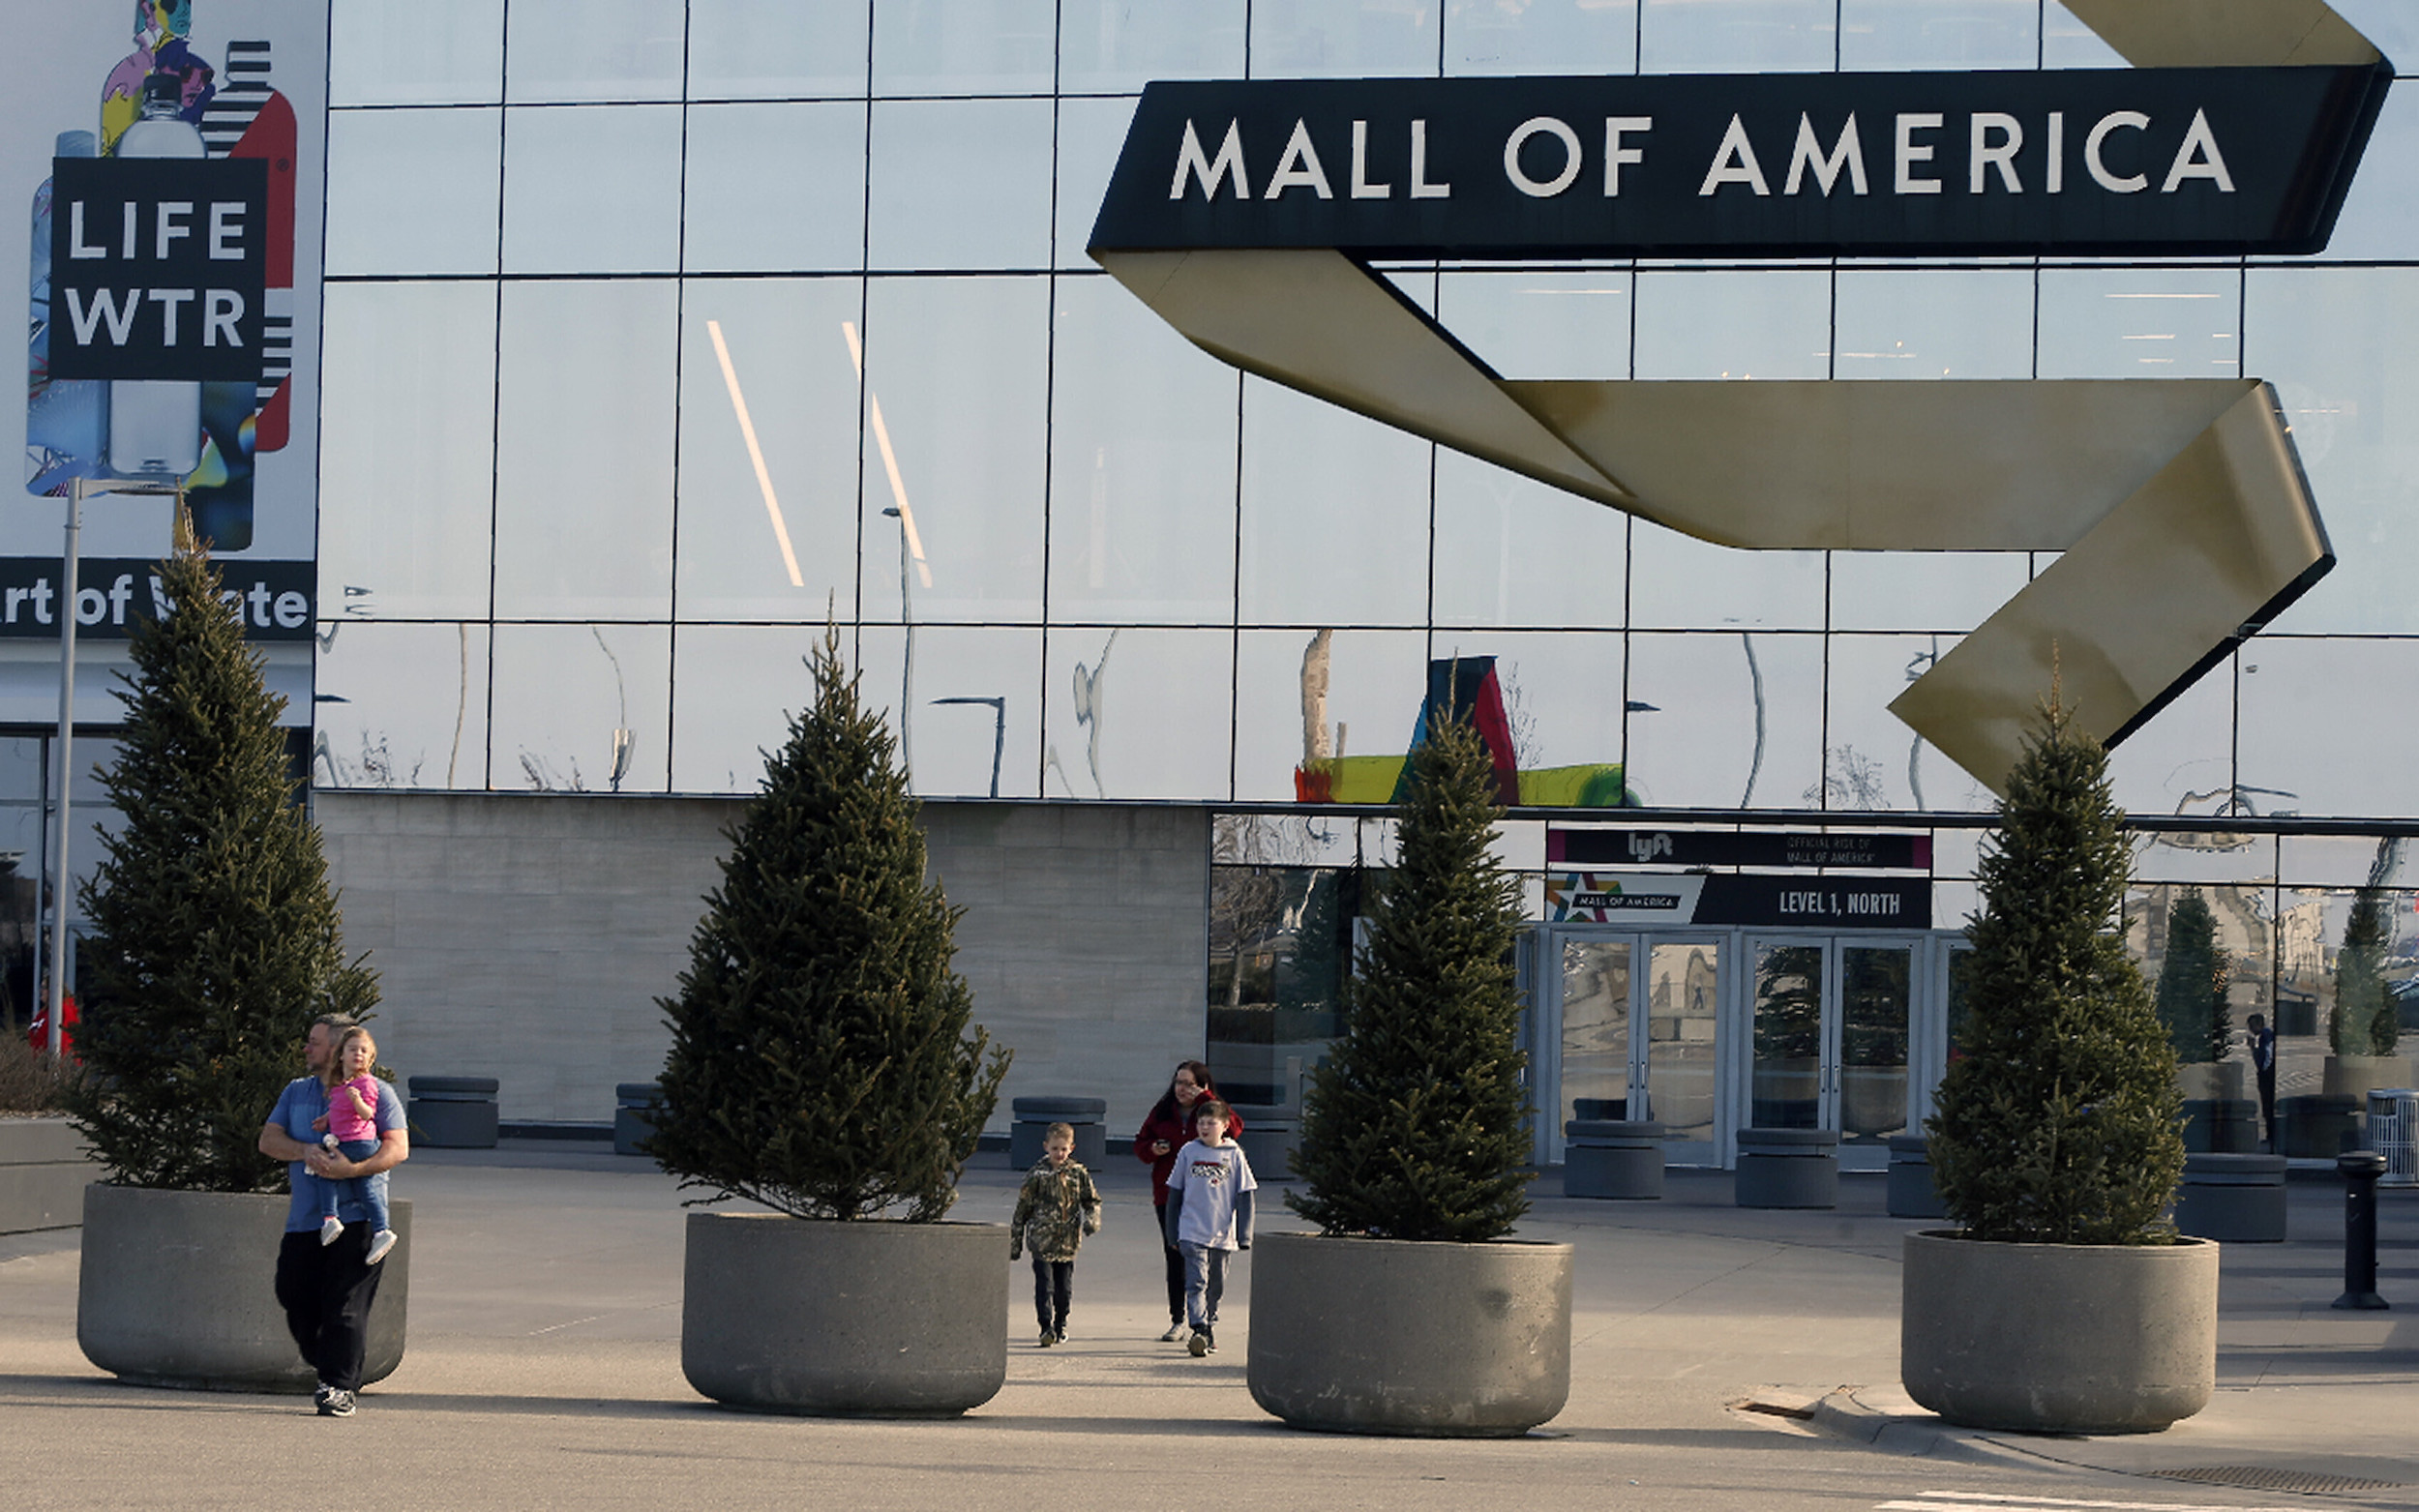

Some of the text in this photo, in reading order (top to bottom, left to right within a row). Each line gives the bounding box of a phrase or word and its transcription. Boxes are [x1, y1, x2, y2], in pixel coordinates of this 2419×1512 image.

[1169, 107, 2236, 202] MALL OF AMERICA
[70, 200, 248, 260] LIFE
[64, 287, 246, 347] WTR
[0, 578, 53, 625] rt
[75, 574, 134, 626] of
[1628, 833, 1673, 862] lyft
[1579, 896, 1674, 907] MALL OF AMERICA
[1779, 891, 1900, 917] LEVEL 1, NORTH
